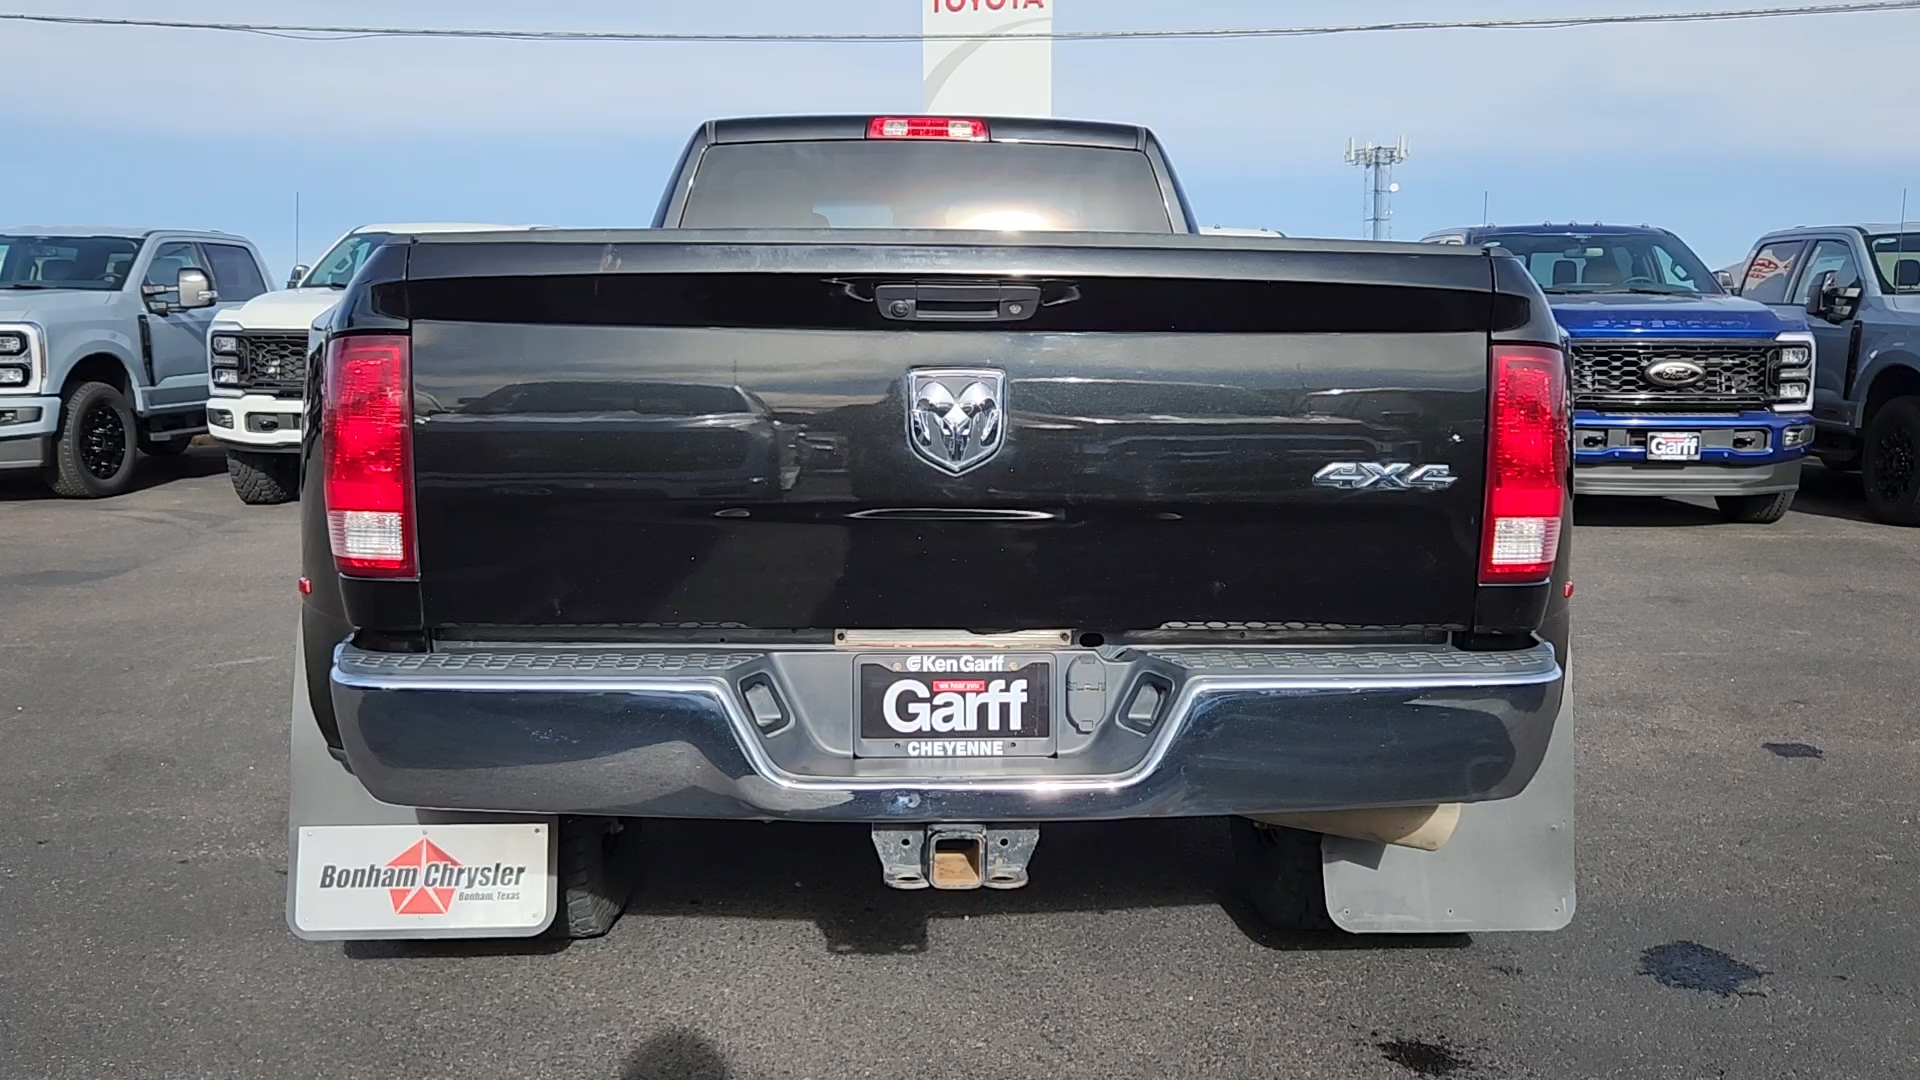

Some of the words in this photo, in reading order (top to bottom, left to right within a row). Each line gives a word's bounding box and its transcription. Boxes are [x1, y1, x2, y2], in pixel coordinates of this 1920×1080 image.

[1651, 437, 1698, 455] Garff
[922, 655, 958, 672] Ken
[960, 654, 1005, 672] Garff
[883, 679, 1028, 733] Garff
[907, 741, 1004, 756] CHEYENNE
[319, 864, 419, 889] Bonham
[424, 862, 526, 889] Chrysler
[497, 891, 521, 900] Texas
